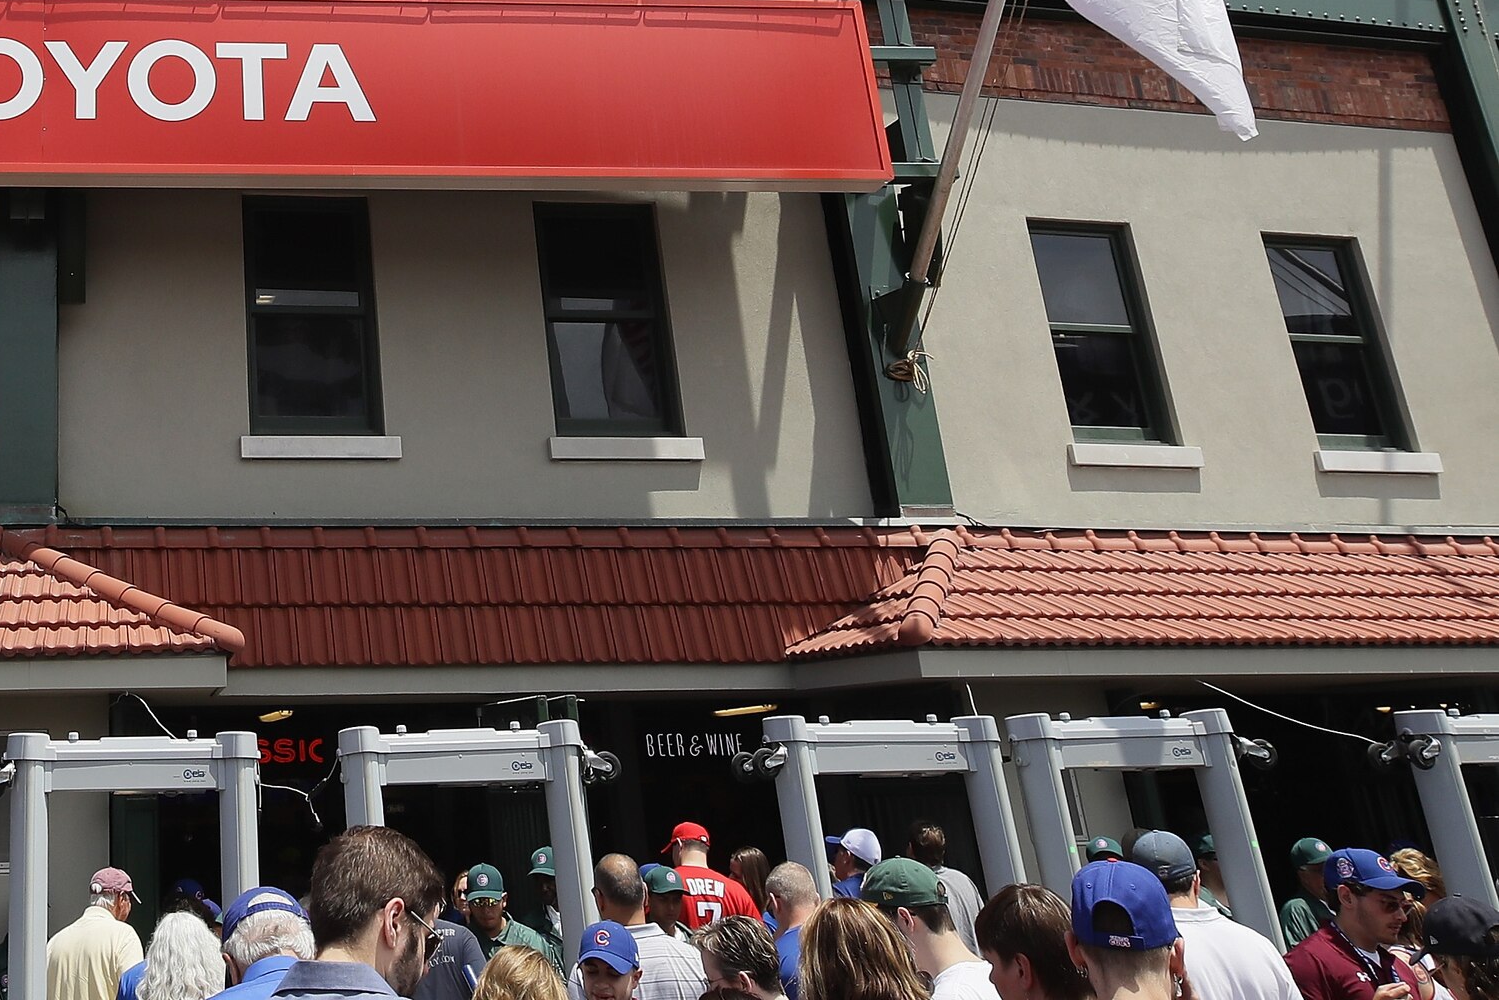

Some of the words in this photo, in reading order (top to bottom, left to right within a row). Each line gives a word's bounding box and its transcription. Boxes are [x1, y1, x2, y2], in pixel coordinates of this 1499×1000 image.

[645, 733, 685, 757] BEER
[689, 735, 704, 757] &
[704, 733, 742, 756] WINE
[685, 878, 725, 898] DREW
[696, 901, 722, 924] 7
